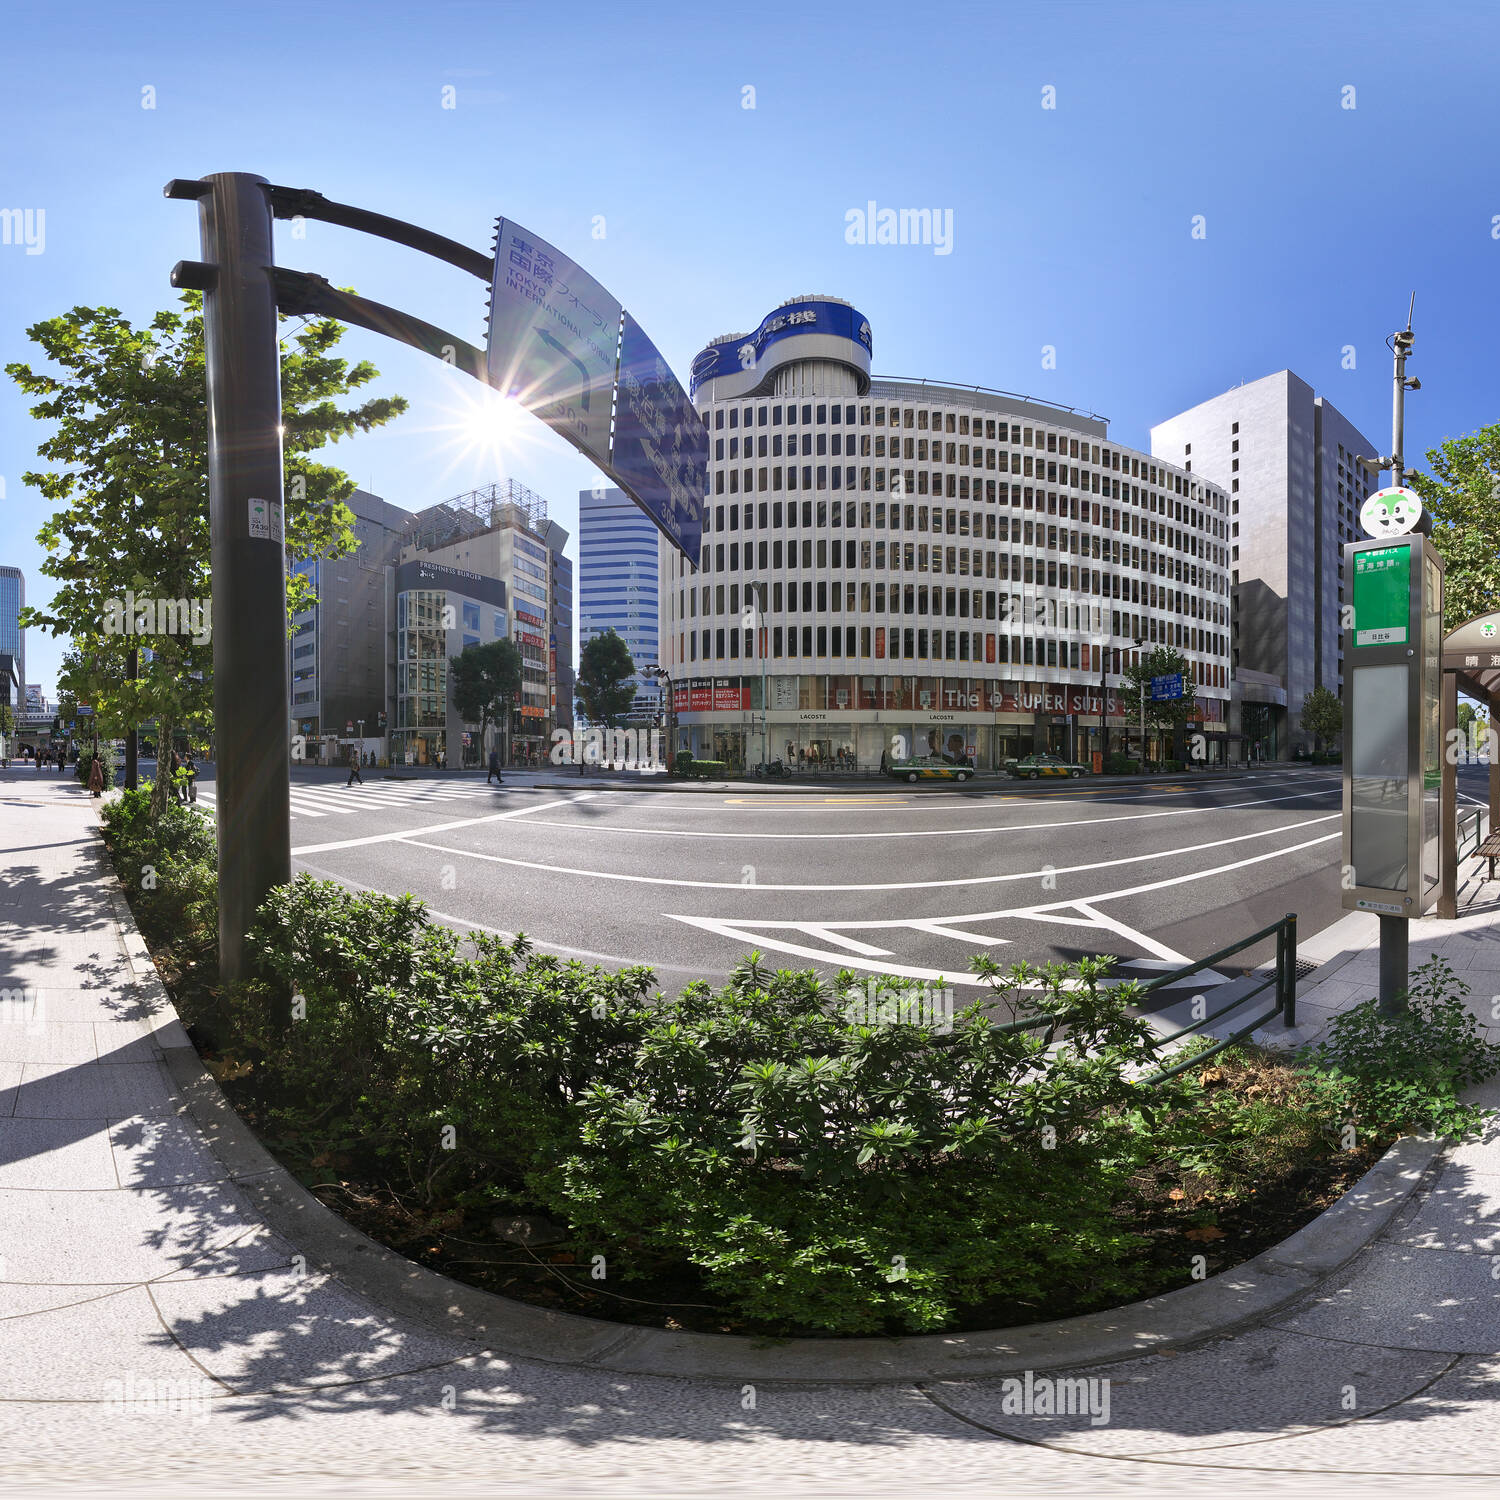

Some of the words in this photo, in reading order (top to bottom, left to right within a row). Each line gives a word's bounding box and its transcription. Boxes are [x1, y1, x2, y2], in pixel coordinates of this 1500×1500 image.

[511, 236, 555, 272] 東京
[508, 267, 546, 297] TOKYO
[506, 277, 582, 337] INTERNATIONAL
[587, 336, 611, 367] FORUM
[661, 503, 681, 537] 300m
[419, 561, 456, 575] FRESHNESS
[457, 569, 482, 582] BURGER
[945, 690, 979, 707] The
[1013, 693, 1064, 712] SUPER
[1073, 695, 1116, 712] SUITS
